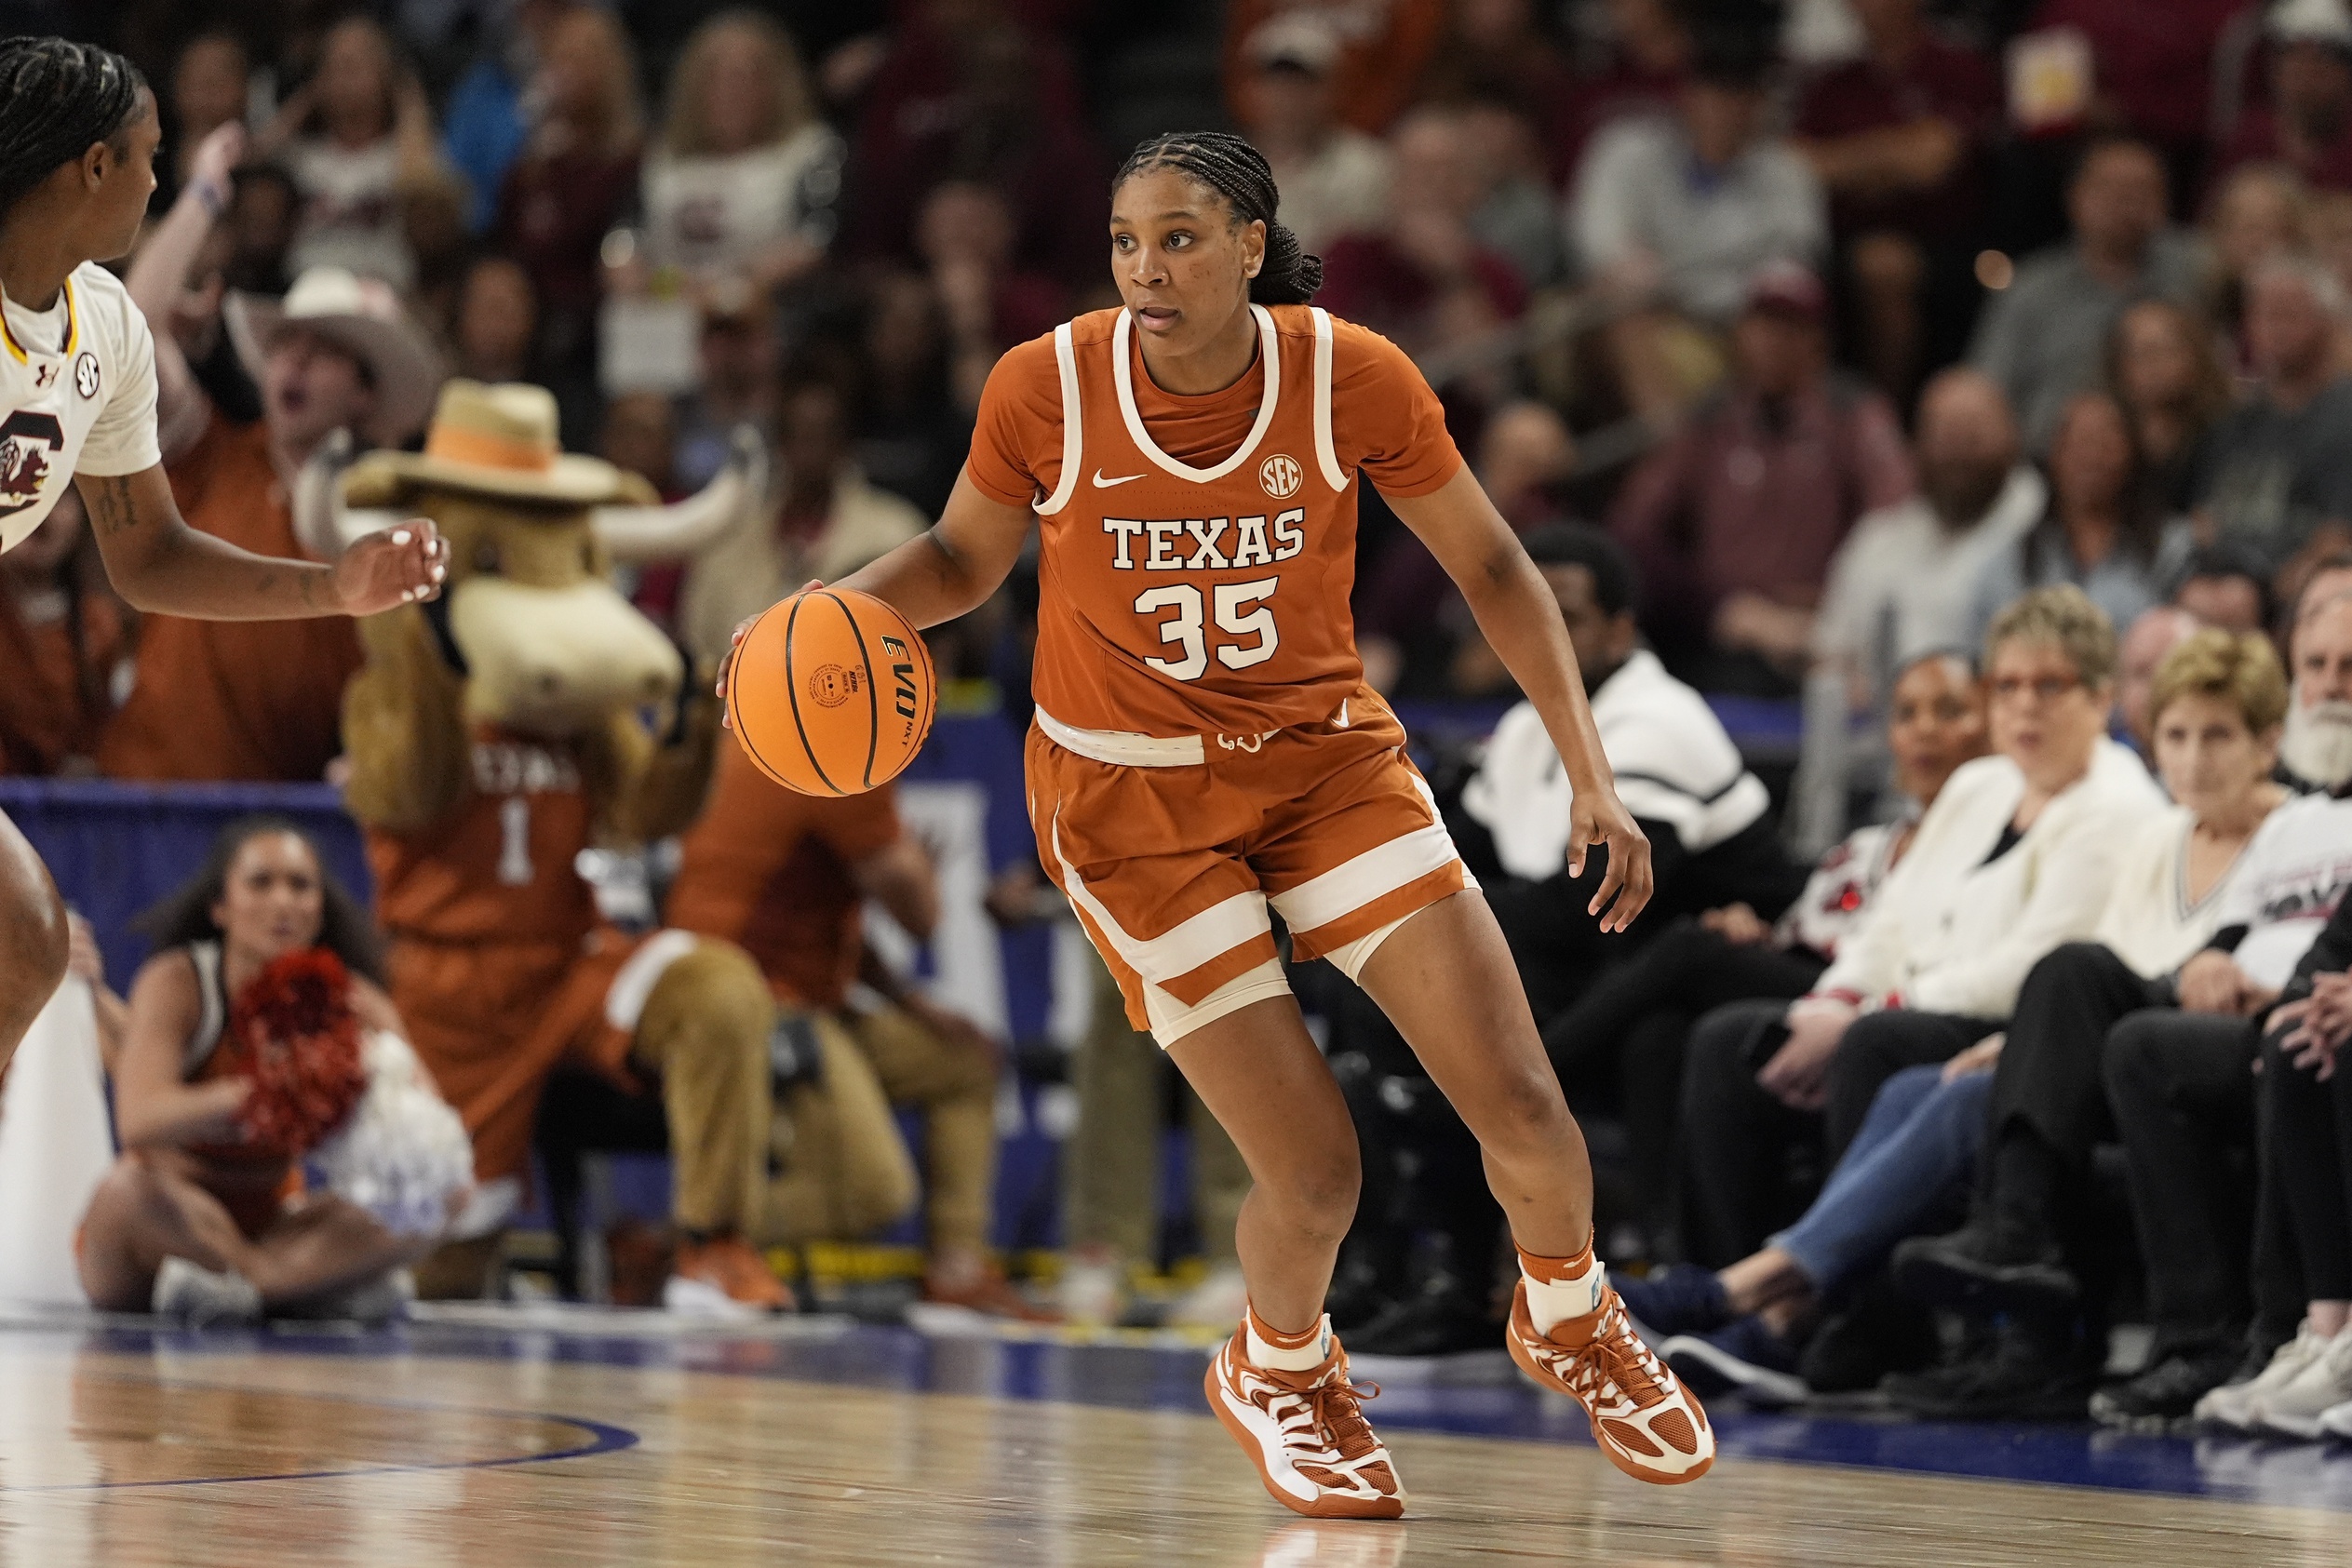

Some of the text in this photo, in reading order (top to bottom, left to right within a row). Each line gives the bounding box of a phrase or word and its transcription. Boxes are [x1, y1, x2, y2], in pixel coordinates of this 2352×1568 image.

[1261, 458, 1300, 496] SEC
[1102, 506, 1305, 570] TEXAS
[1133, 574, 1280, 682] 35
[880, 635, 917, 748] EVO NXT
[498, 798, 536, 884] 1
